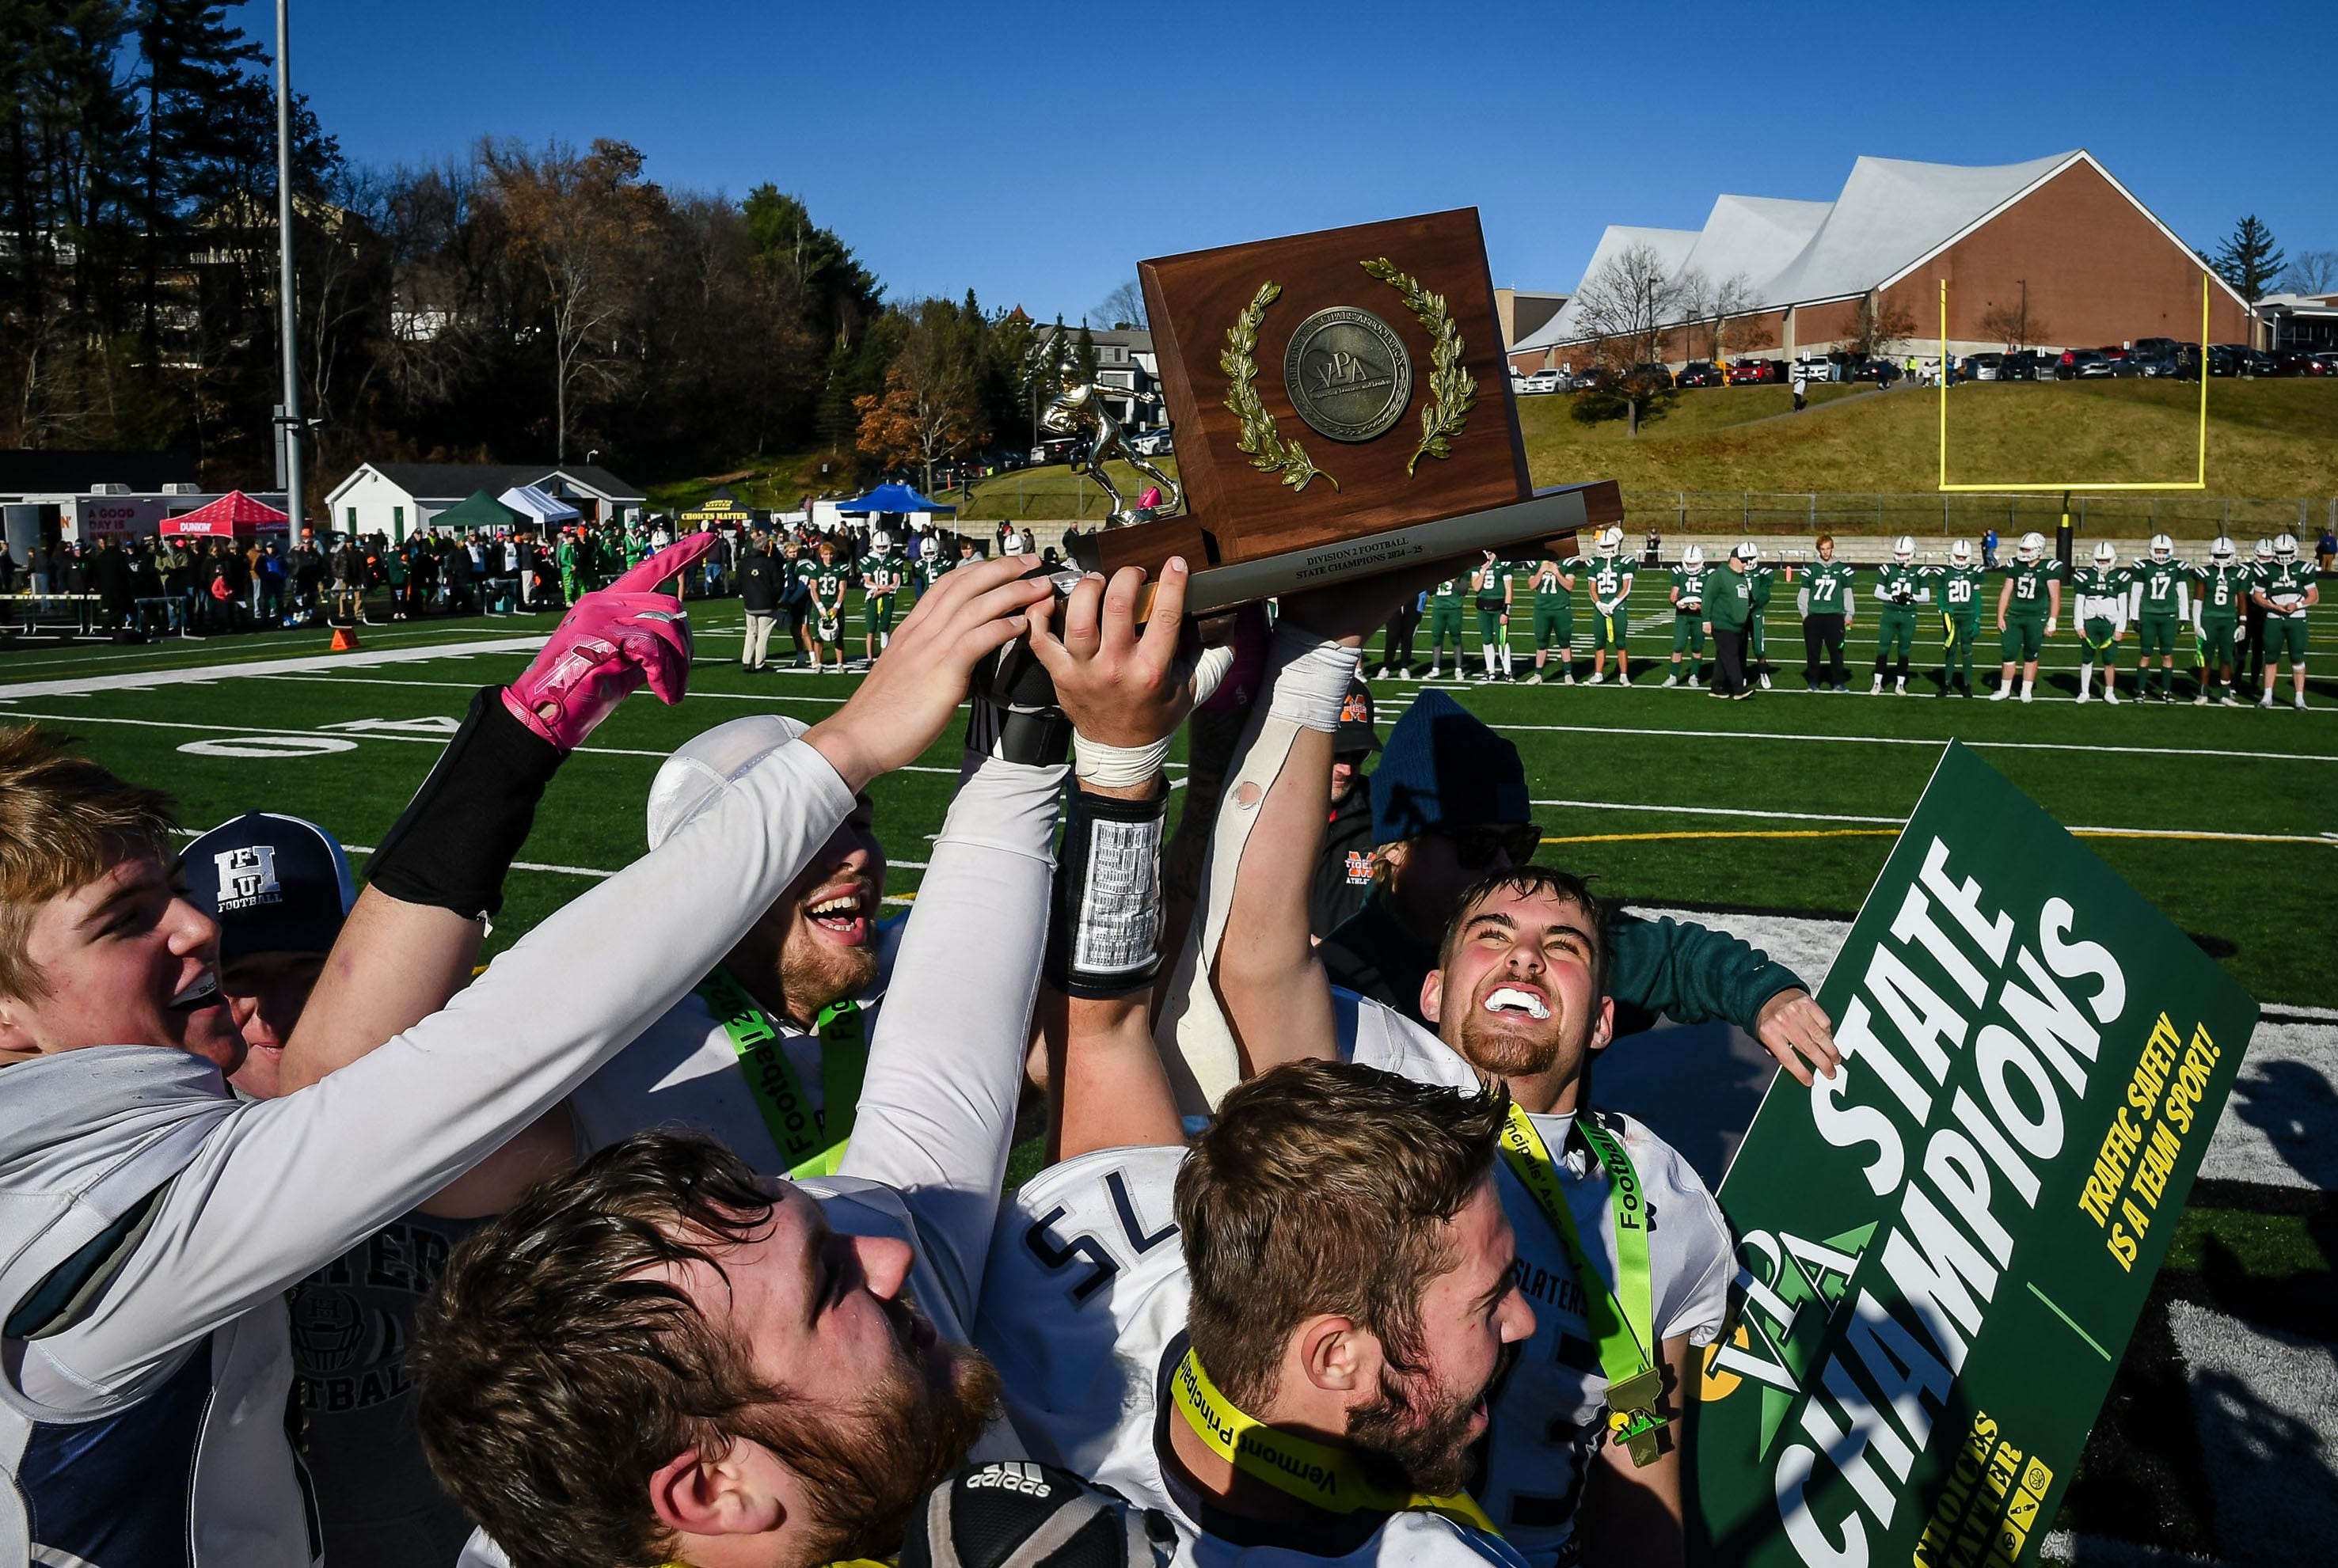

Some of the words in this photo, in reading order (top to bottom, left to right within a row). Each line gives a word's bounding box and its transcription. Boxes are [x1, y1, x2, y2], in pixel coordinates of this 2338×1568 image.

[1316, 351, 1367, 388] VPA
[88, 509, 96, 518] A
[100, 508, 135, 518] GOOD
[89, 520, 111, 530] DAY
[113, 520, 125, 530] IS
[180, 522, 212, 533] DUNKIN'
[1296, 565, 1326, 579] STATE
[1328, 554, 1386, 572] CHAMPIONS
[1387, 549, 1406, 560] 2024
[1413, 545, 1424, 554] 25
[1306, 549, 1351, 566] DIVISION
[1359, 537, 1409, 556] FOOTBALL
[819, 576, 837, 595] 33
[872, 570, 889, 586] 18
[1541, 573, 1557, 594] 71
[1596, 572, 1618, 594] 25
[1814, 579, 1837, 601] 77
[1948, 580, 1971, 602] 20
[2017, 577, 2036, 599] 51
[2150, 575, 2172, 599] 17
[2214, 586, 2228, 605] 6
[217, 893, 283, 913] FOOTBALL
[1810, 834, 2016, 1196] STATE
[2165, 1020, 2222, 1134] SPORT!
[739, 1030, 815, 1156] Football
[2078, 1106, 2142, 1228] TRAFFIC
[2127, 1011, 2181, 1121] SAFETY
[1589, 1127, 1641, 1230] Football
[2131, 1118, 2181, 1210] TEAM
[1774, 896, 2127, 1568] CHAMPIONS
[2121, 1197, 2150, 1240] A
[2106, 1222, 2137, 1274] IS
[1709, 1229, 1864, 1394] VPA
[1234, 1433, 1339, 1496] Vermont
[966, 1469, 1051, 1498] adidas
